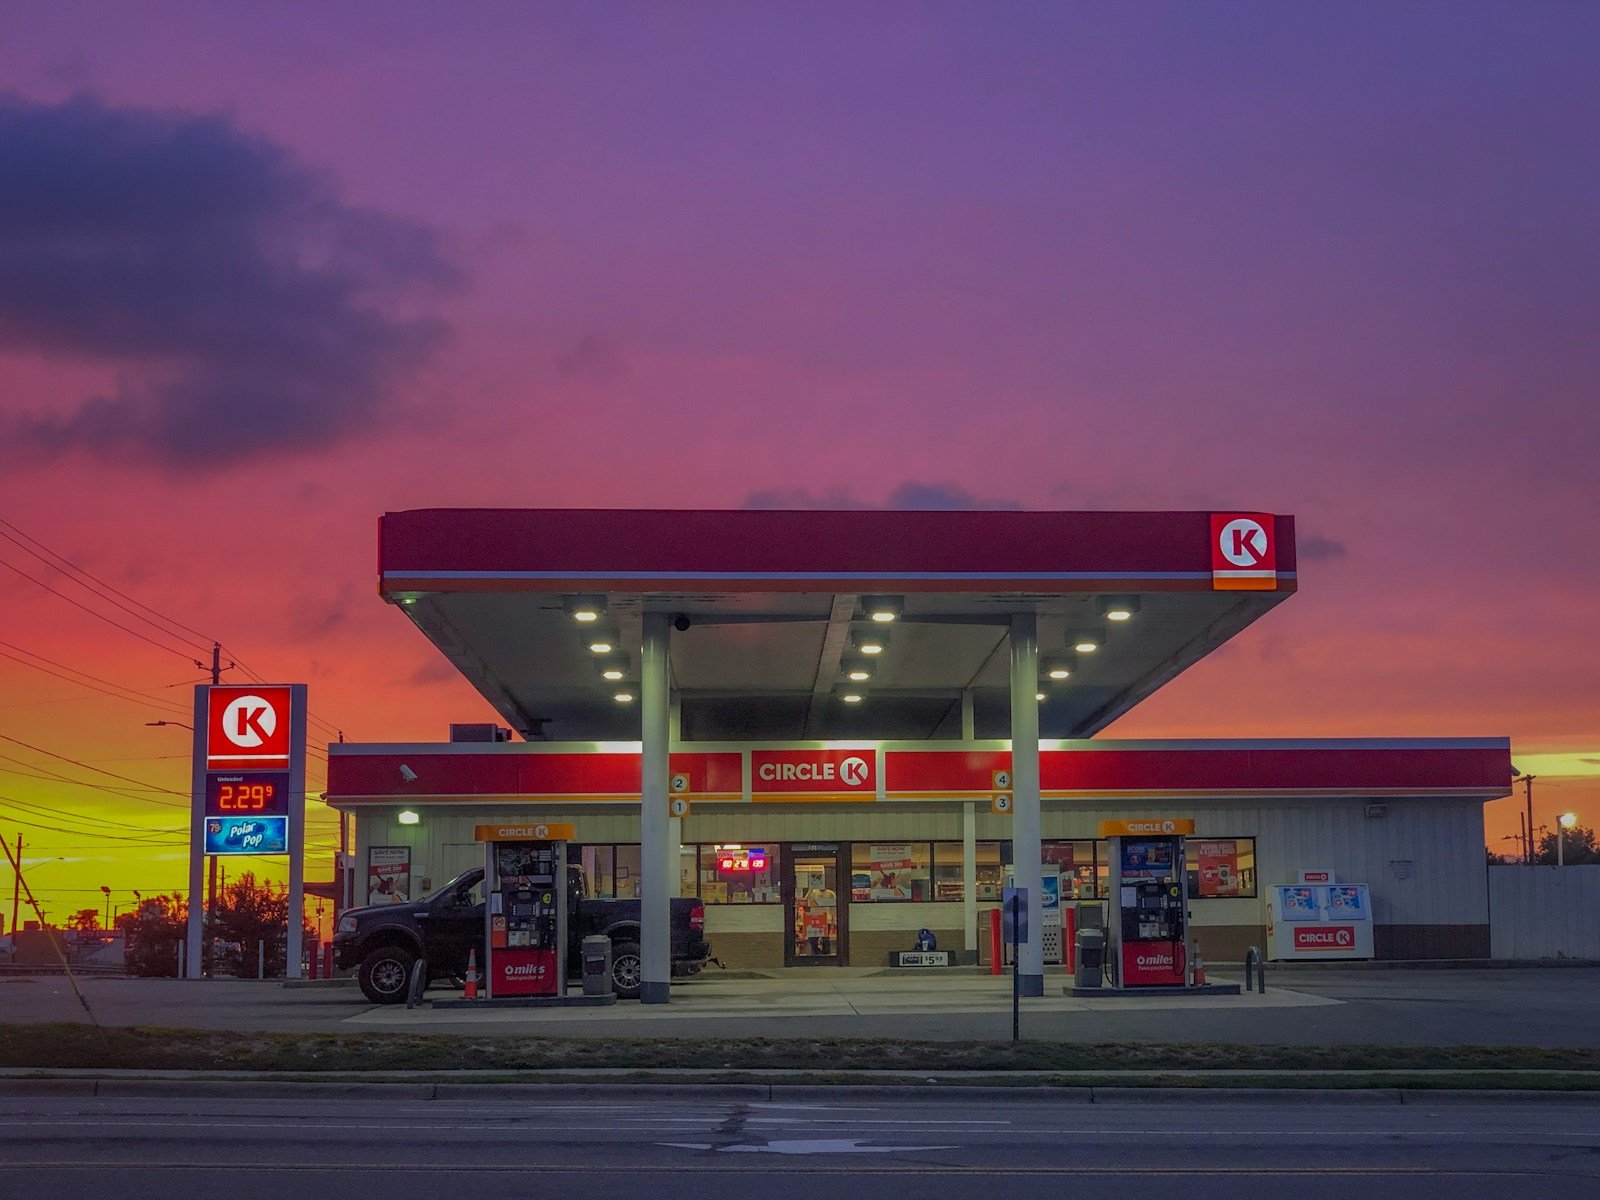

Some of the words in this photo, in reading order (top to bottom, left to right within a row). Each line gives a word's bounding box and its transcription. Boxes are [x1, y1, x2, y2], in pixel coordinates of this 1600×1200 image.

[759, 763, 835, 781] CIRCLE
[845, 760, 867, 783] K
[675, 778, 683, 788] 2
[999, 775, 1006, 785] 4
[677, 802, 682, 812] 1
[999, 798, 1006, 808] 3
[230, 822, 257, 838] Polar
[498, 828, 533, 837] CIRCLE
[1127, 823, 1160, 832] CIRCLE
[243, 834, 263, 848] Pop
[1299, 933, 1334, 943] CIRCLE
